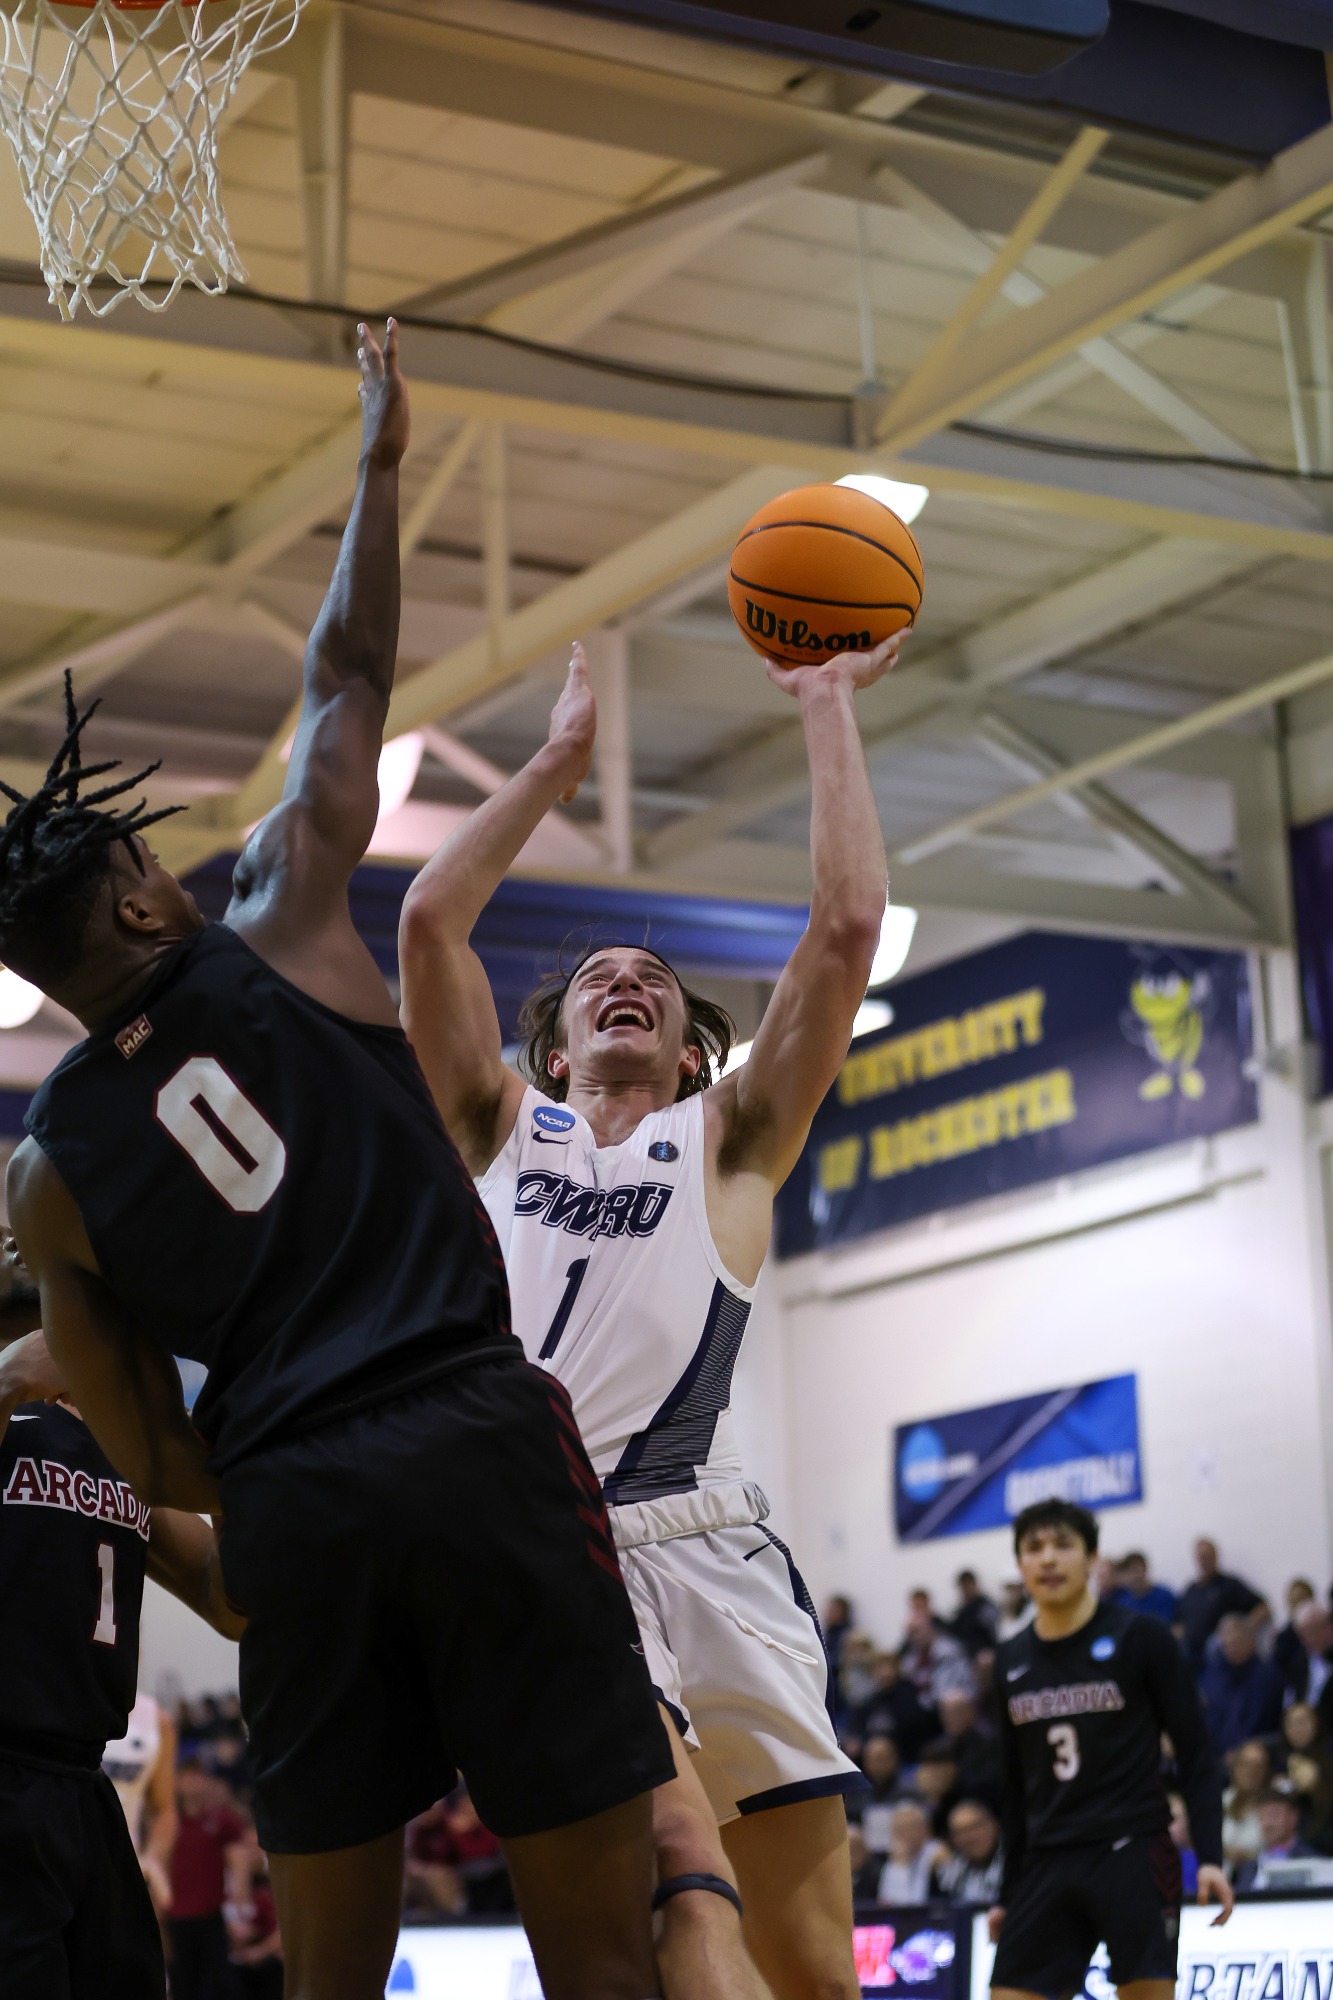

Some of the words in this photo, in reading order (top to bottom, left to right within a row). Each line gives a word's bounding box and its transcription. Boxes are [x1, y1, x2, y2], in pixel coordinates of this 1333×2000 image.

[745, 597, 871, 651] Wilson
[122, 1021, 149, 1054] MAC
[153, 1053, 287, 1216] 0
[537, 1111, 572, 1130] NCAA
[513, 1169, 675, 1241] CWRU
[537, 1254, 591, 1361] 1
[91, 1541, 118, 1647] 1
[1008, 1680, 1126, 1727] ARCADIA
[1046, 1722, 1081, 1782] 3
